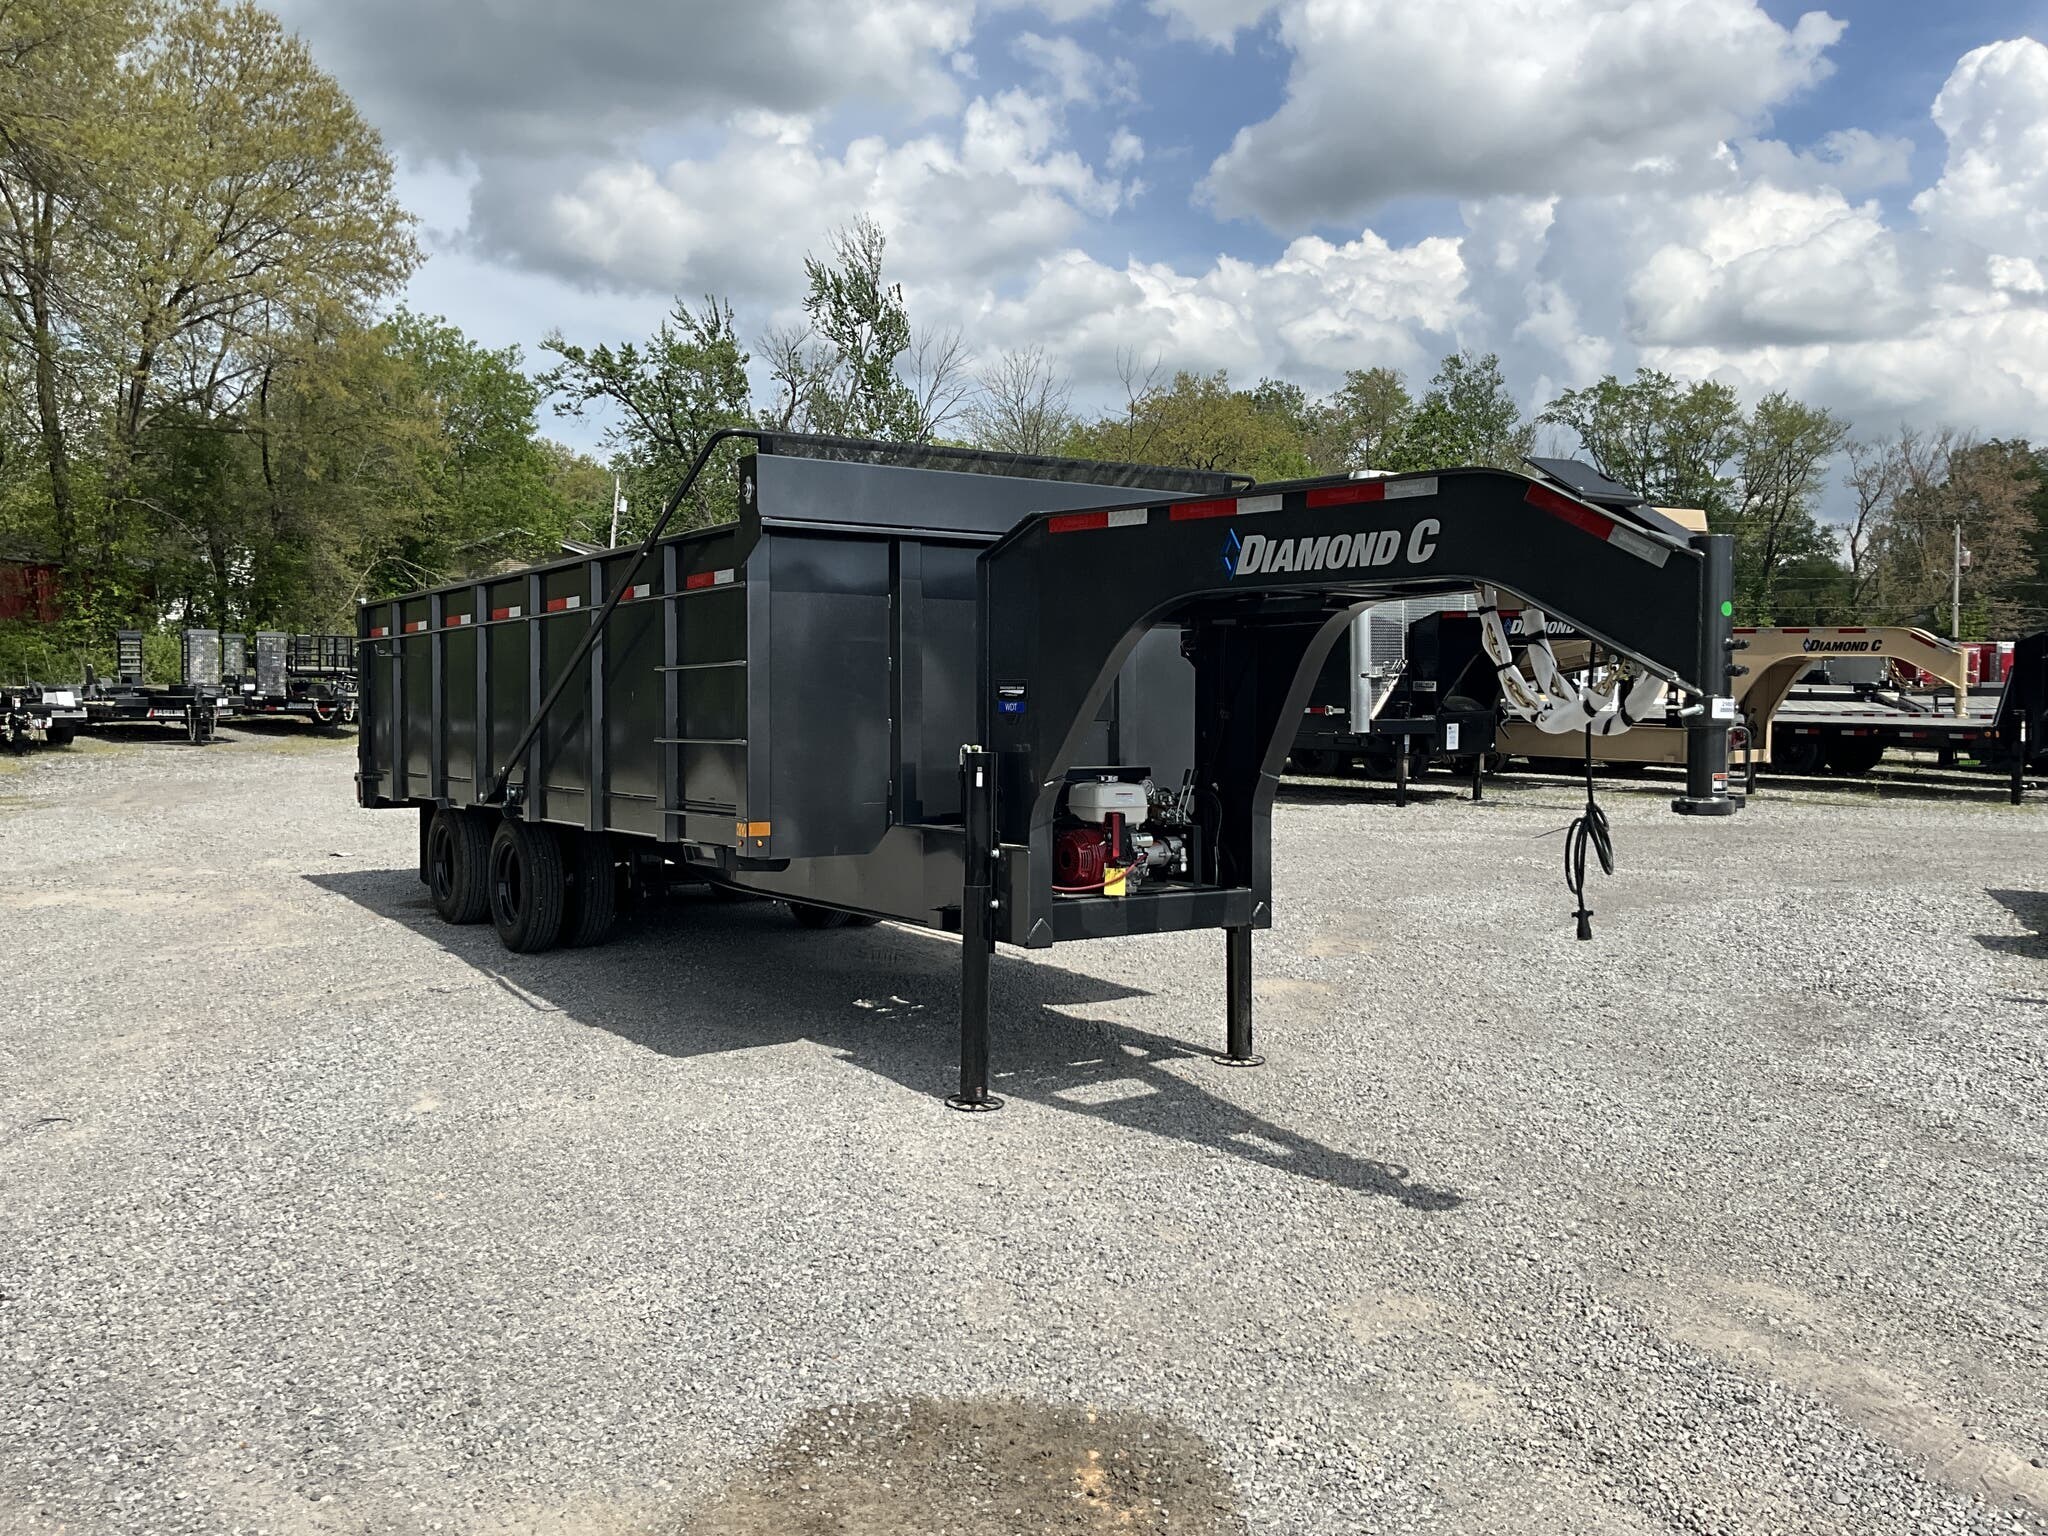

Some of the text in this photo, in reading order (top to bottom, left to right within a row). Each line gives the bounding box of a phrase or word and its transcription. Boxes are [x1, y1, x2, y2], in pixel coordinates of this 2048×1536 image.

[1236, 518, 1441, 575] DIAMOND C
[1809, 639, 1882, 652] DIAMOND C
